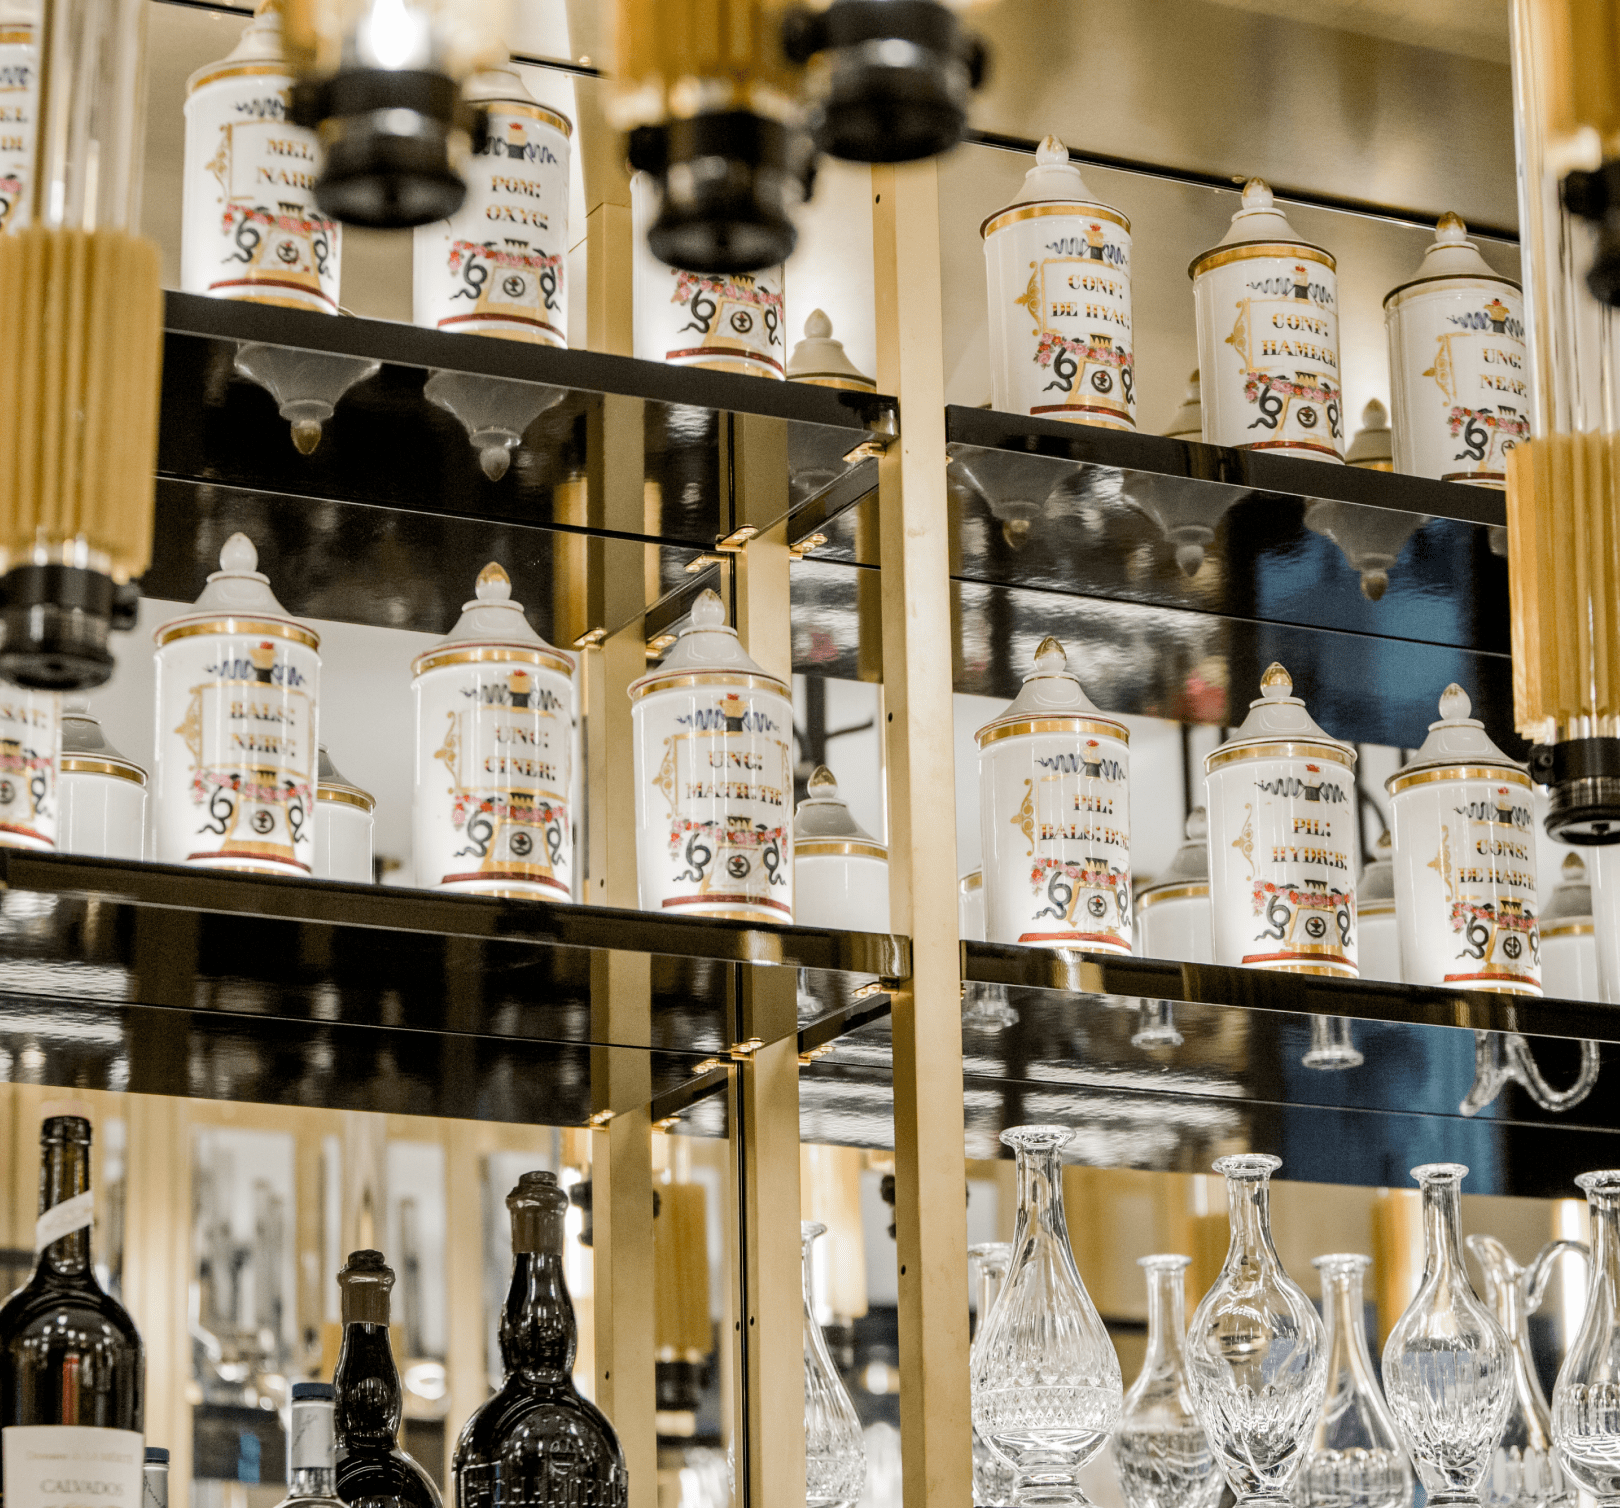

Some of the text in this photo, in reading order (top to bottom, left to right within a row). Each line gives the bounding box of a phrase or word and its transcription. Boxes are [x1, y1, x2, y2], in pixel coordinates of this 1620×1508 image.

[491, 175, 540, 198] POM:
[1068, 274, 1123, 299] CONF:
[1050, 301, 1078, 317] DE
[1272, 313, 1328, 337] CONF:
[1482, 348, 1521, 369] UNG:
[708, 751, 763, 771] UNG:
[1072, 794, 1113, 815] PIL:
[1292, 818, 1331, 838] PIL:
[1476, 839, 1528, 861] CONS:
[1458, 867, 1483, 883] DE
